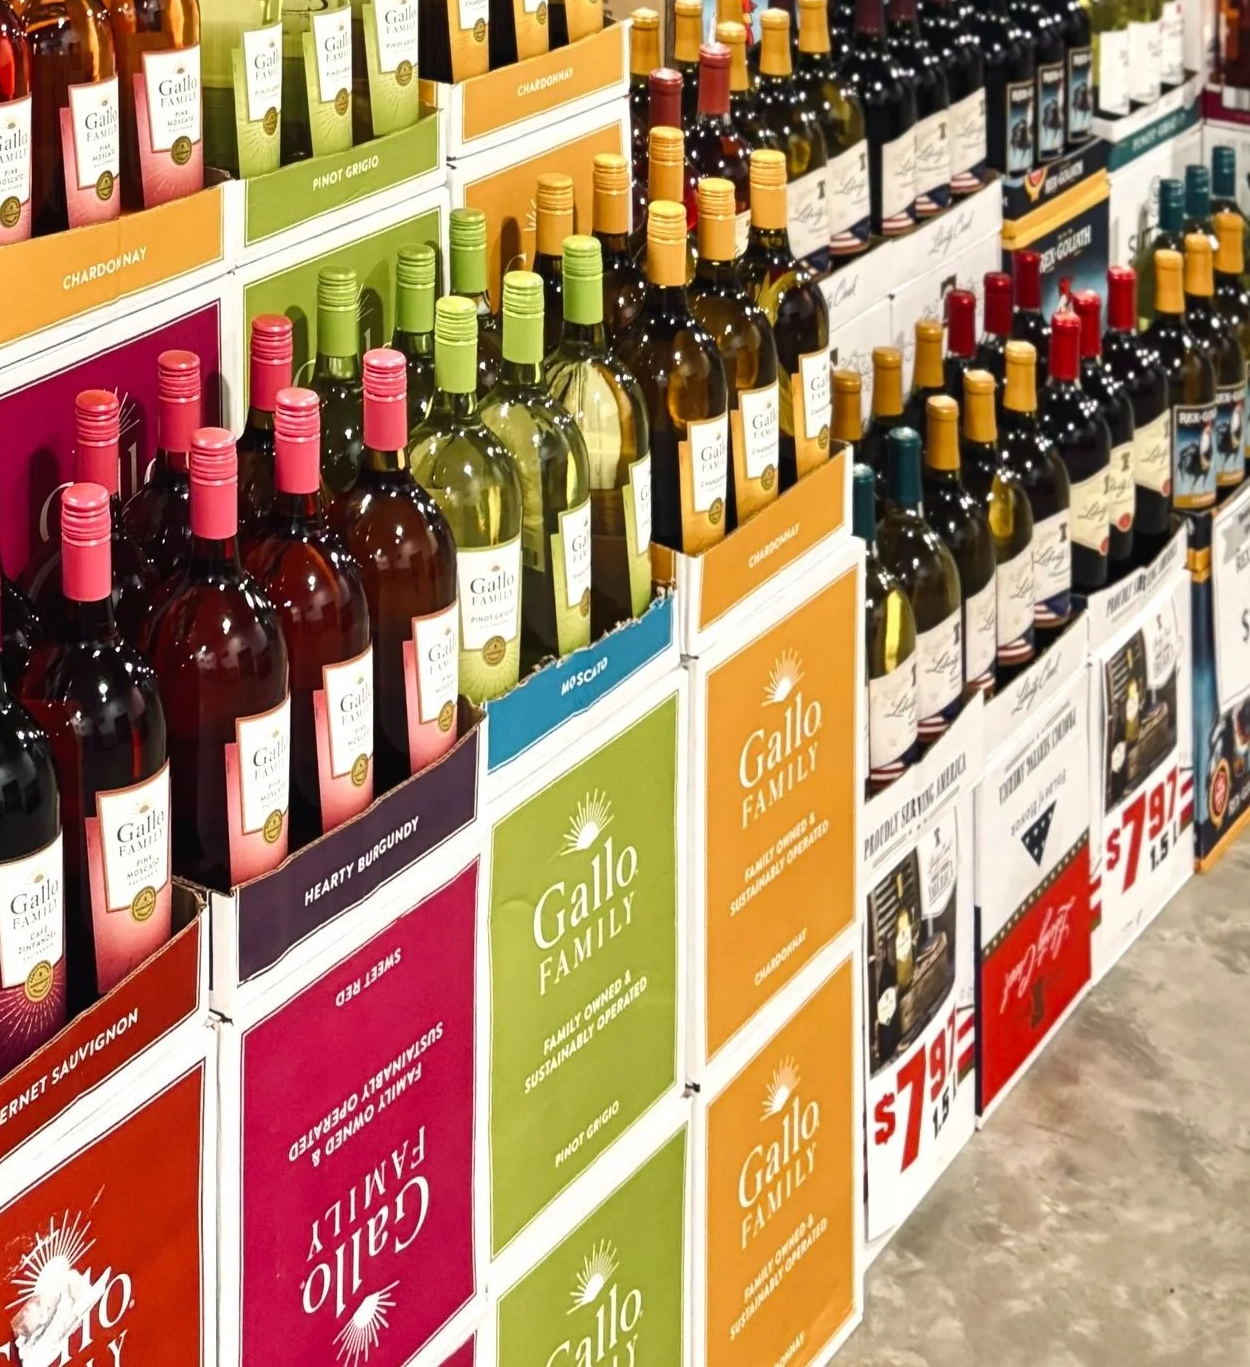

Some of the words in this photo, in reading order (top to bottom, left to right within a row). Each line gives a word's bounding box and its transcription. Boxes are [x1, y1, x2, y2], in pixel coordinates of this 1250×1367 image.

[158, 74, 197, 97] Gallo
[517, 67, 574, 98] CHARDONNAY
[84, 106, 117, 131] Gallo
[312, 169, 343, 191] PINOT
[345, 155, 379, 178] GRIGIO
[63, 246, 148, 291] CHARDONNAY
[749, 522, 800, 569] CHARDONNAY
[470, 571, 514, 595] Gallo
[561, 656, 608, 696] MOSCATO
[739, 691, 822, 789] Gallo
[741, 742, 819, 831] FAMILY
[864, 814, 898, 862] PROUDLY
[901, 783, 934, 826] SERVING
[936, 751, 967, 800] AMERICA
[116, 806, 165, 844] Gallo
[118, 828, 164, 858] FAMILY
[744, 848, 774, 885] FAMILY
[775, 818, 807, 854] OWNED
[304, 862, 354, 907] HEARTY
[357, 816, 419, 873] BURGUNDY
[533, 836, 639, 951] Gallo
[729, 860, 785, 917] SUSTAINABLY
[786, 819, 829, 865] OPERATED
[10, 876, 59, 916] Gallo
[12, 900, 59, 931] FAMILY
[363, 947, 402, 992] SWEET
[538, 891, 636, 996] FAMILY
[754, 928, 808, 987] CHARDONNAY
[336, 982, 362, 1007] RED
[543, 1014, 581, 1056] FAMILY
[584, 982, 623, 1022] OWNED
[624, 973, 632, 986] &
[51, 1008, 139, 1085] SAUVIGNON
[361, 1021, 445, 1102] SUSTAINABLY
[524, 1025, 594, 1095] SUSTAINABLY
[597, 975, 648, 1031] OPERATED
[378, 1062, 423, 1114] FAMILY
[288, 1094, 357, 1163] OPERATED
[311, 1148, 323, 1168] &
[325, 1104, 375, 1155] OWNED
[554, 1133, 585, 1168] PINOT
[586, 1100, 619, 1136] GRIGIO
[738, 1096, 819, 1209] Gallo
[306, 1125, 427, 1261] FAMILY
[740, 1141, 817, 1250] FAMILY
[301, 1174, 430, 1320] Gallo
[729, 1269, 784, 1341] SUSTAINABLY
[785, 1218, 828, 1274] OPERATED
[743, 1257, 774, 1304] FAMILY
[774, 1222, 807, 1265] OWNED
